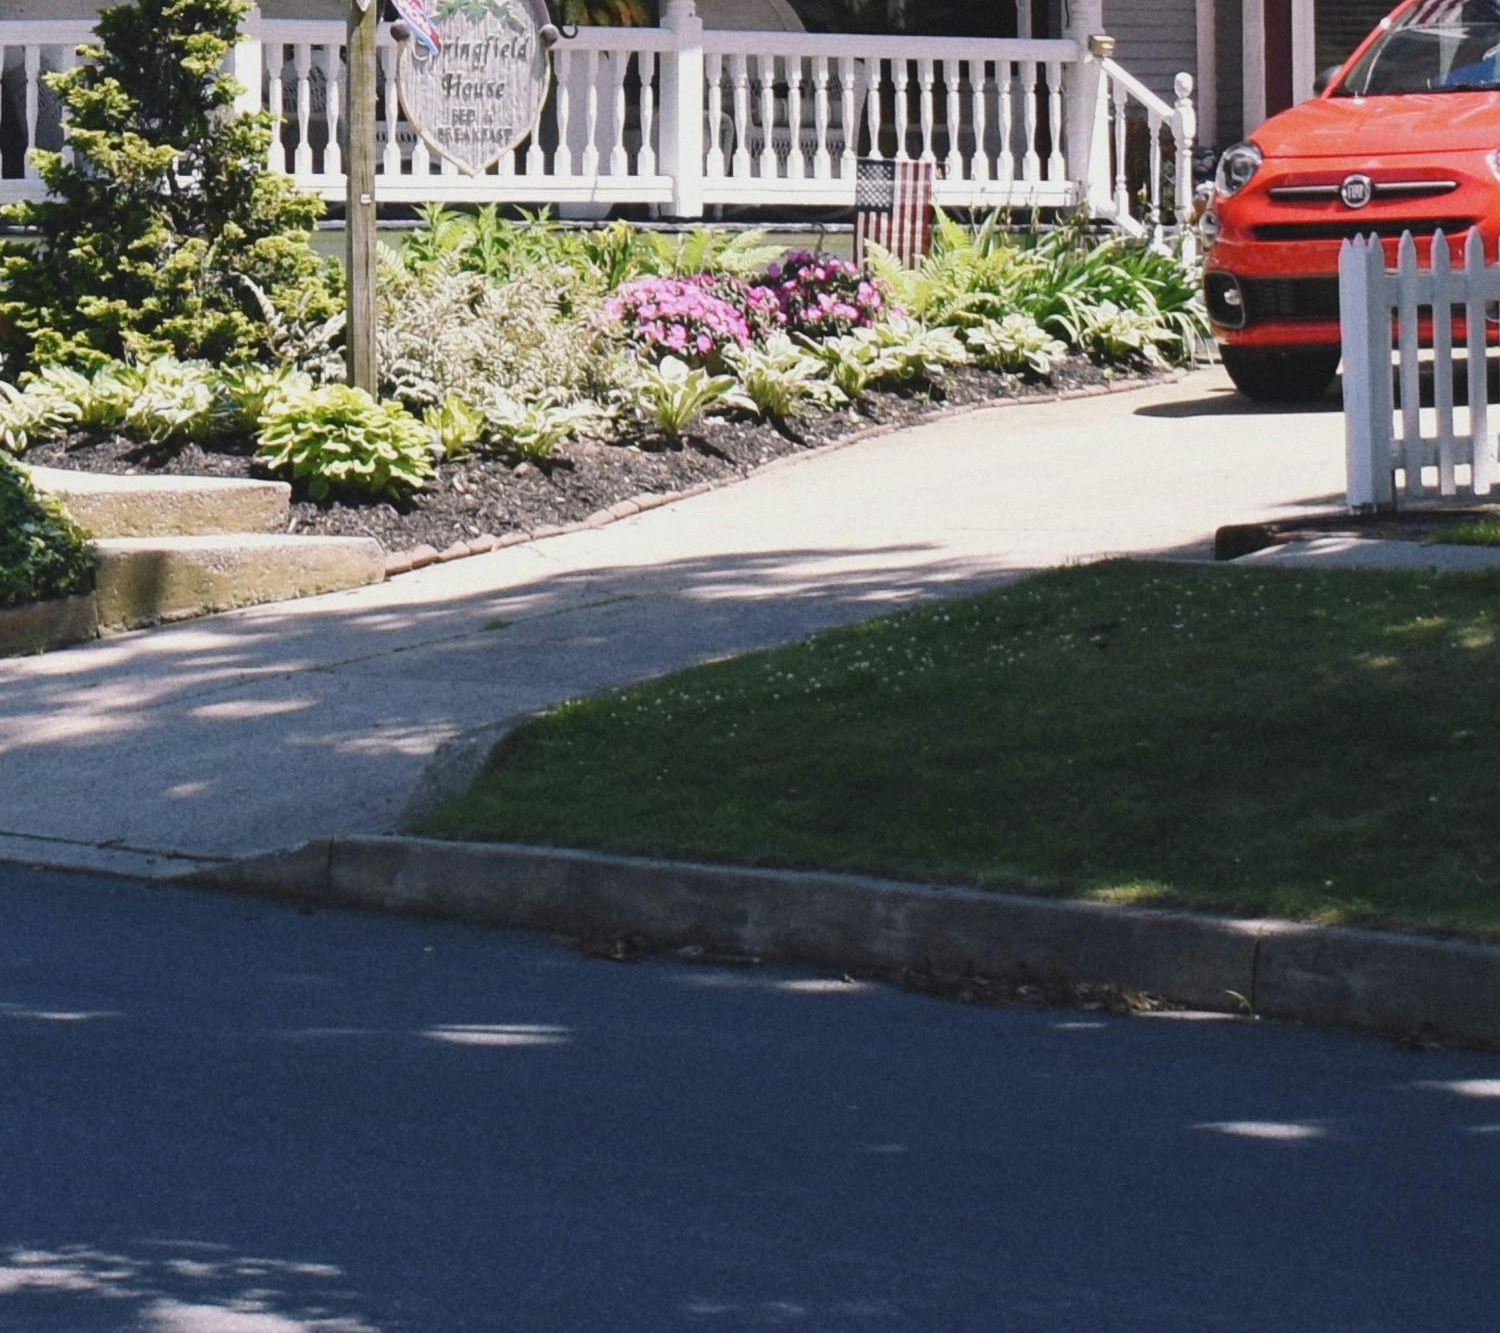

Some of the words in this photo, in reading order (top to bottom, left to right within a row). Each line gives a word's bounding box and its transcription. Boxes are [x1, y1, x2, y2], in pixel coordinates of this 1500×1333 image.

[413, 35, 530, 71] ringfield
[442, 73, 505, 100] House
[437, 127, 513, 148] BREAKFAST
